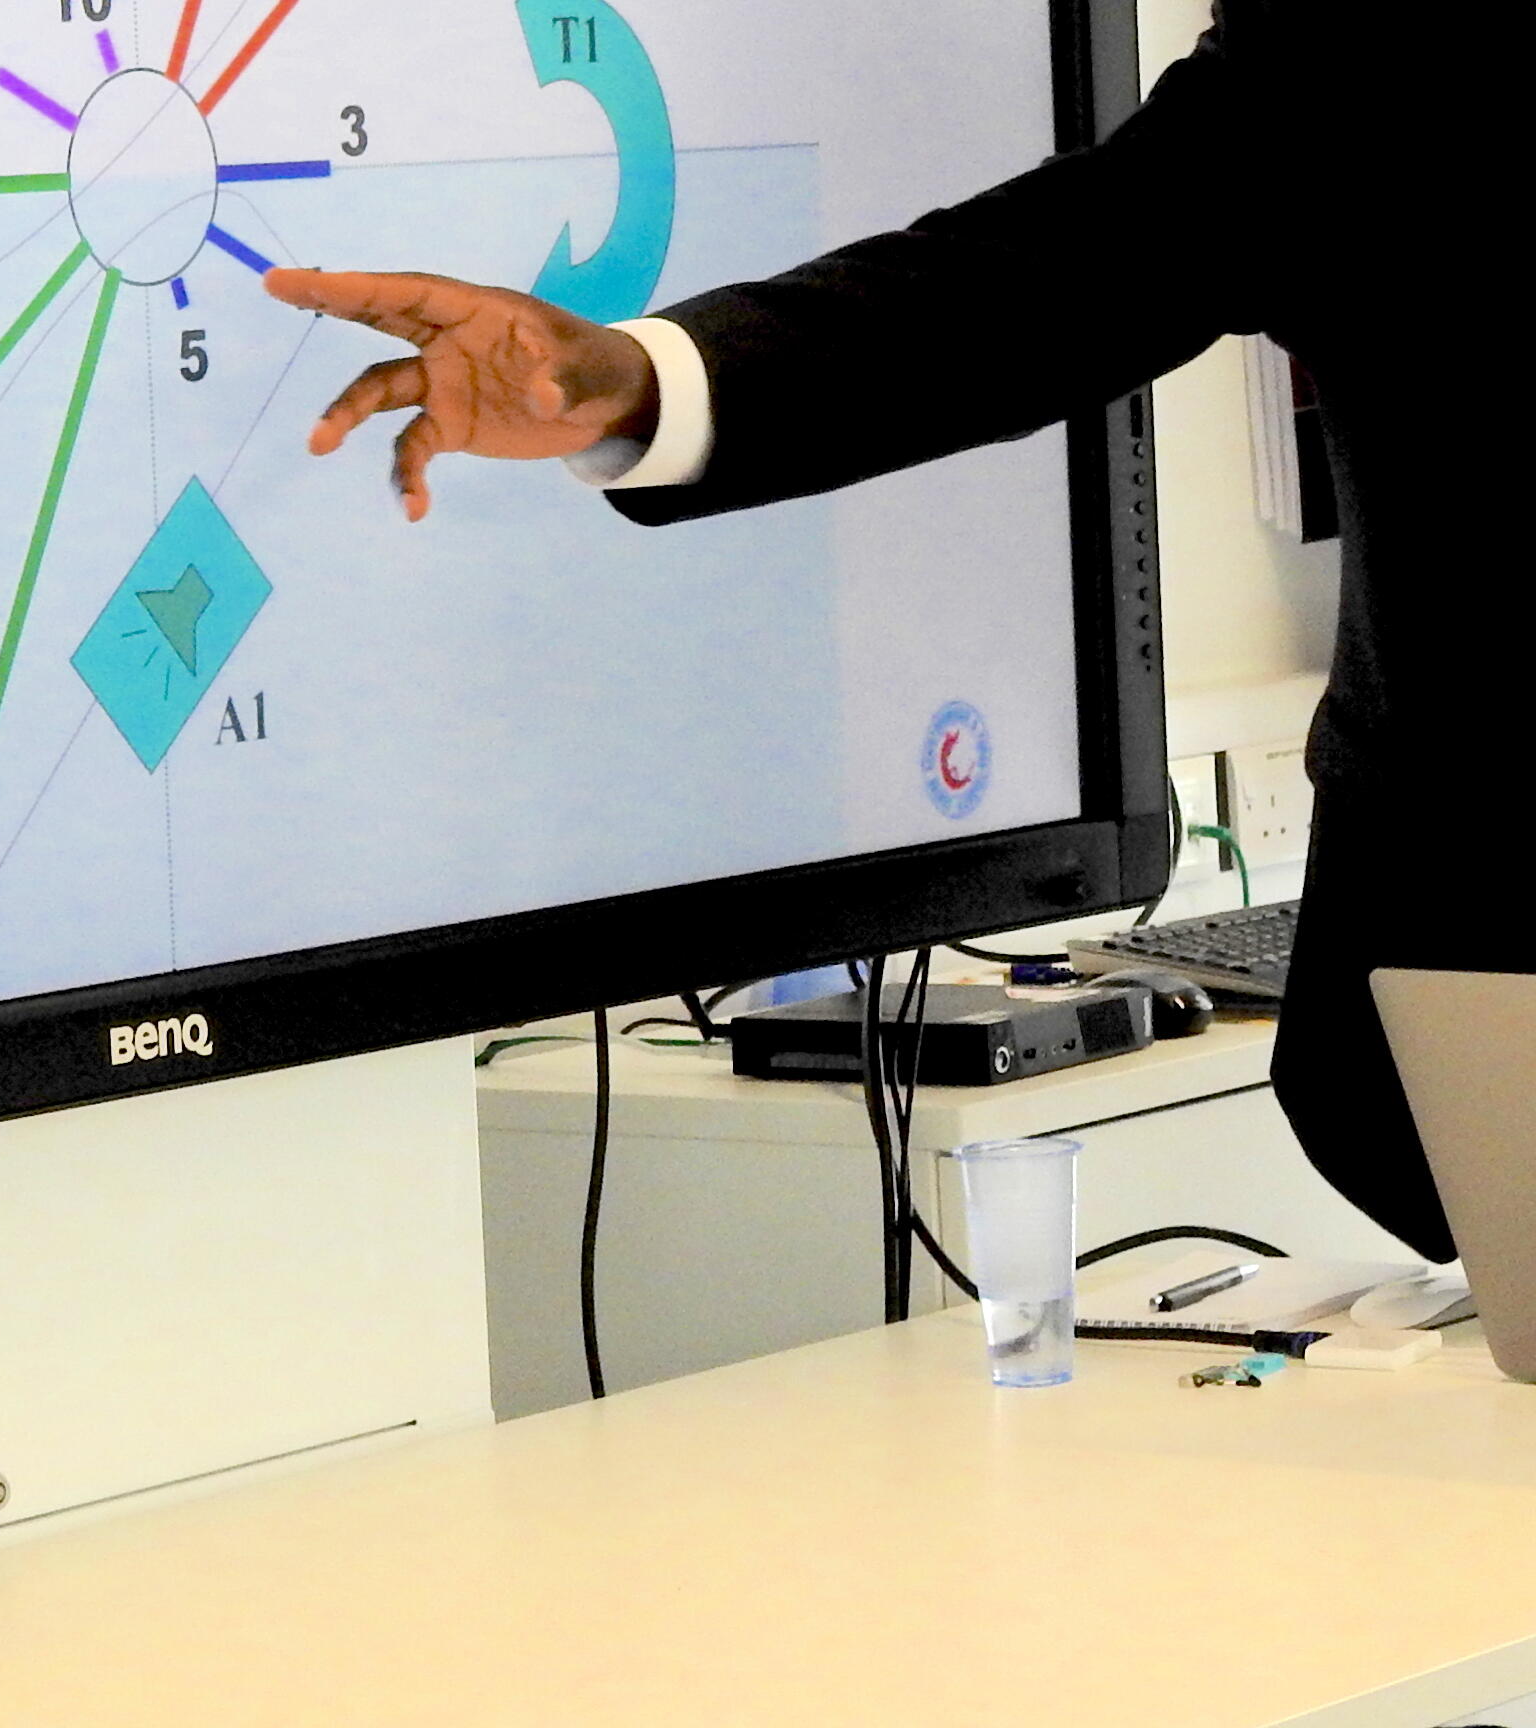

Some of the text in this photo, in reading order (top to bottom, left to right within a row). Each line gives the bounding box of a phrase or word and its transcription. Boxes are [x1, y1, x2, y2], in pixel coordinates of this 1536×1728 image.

[552, 16, 597, 63] T1
[340, 106, 367, 156] 3
[179, 330, 208, 381] 5
[215, 692, 268, 745] A1
